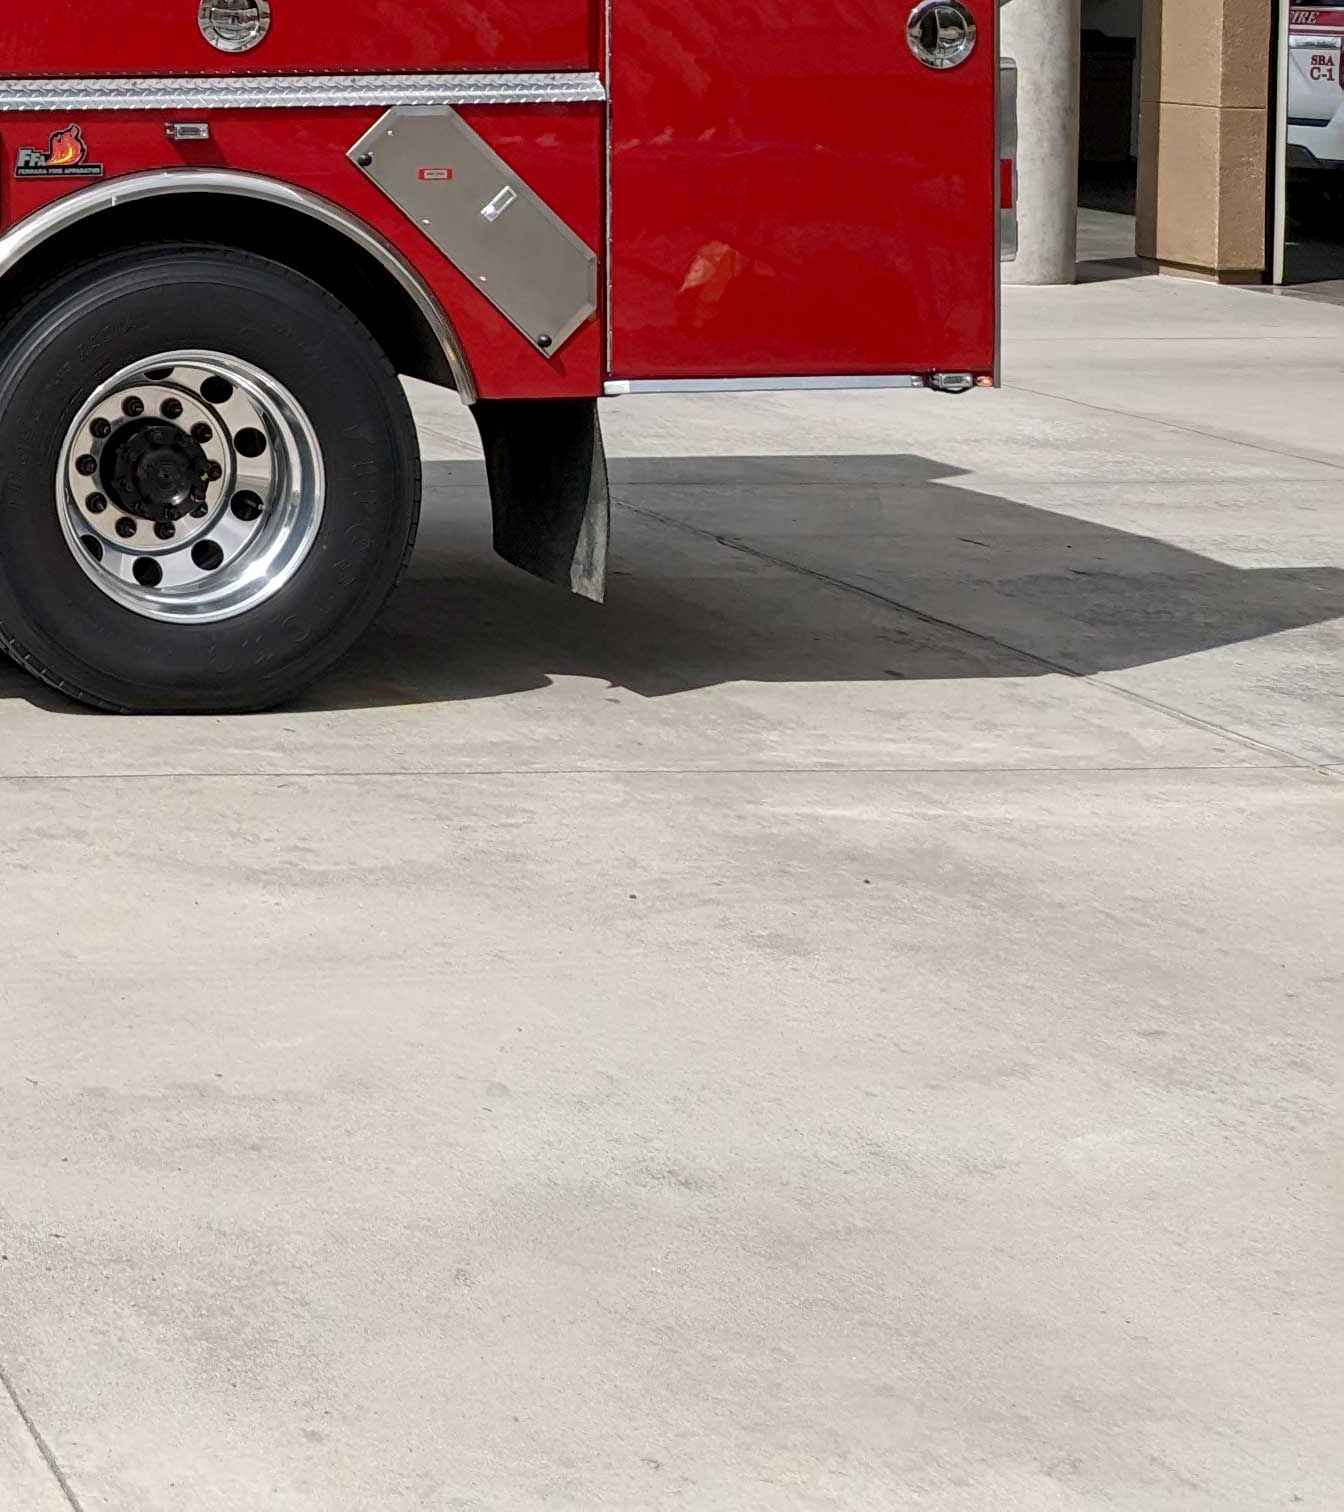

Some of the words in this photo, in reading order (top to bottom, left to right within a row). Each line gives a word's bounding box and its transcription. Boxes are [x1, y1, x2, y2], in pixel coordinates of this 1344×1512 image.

[1289, 11, 1319, 24] IRE
[1310, 54, 1334, 66] SBA
[1310, 67, 1335, 81] C-1
